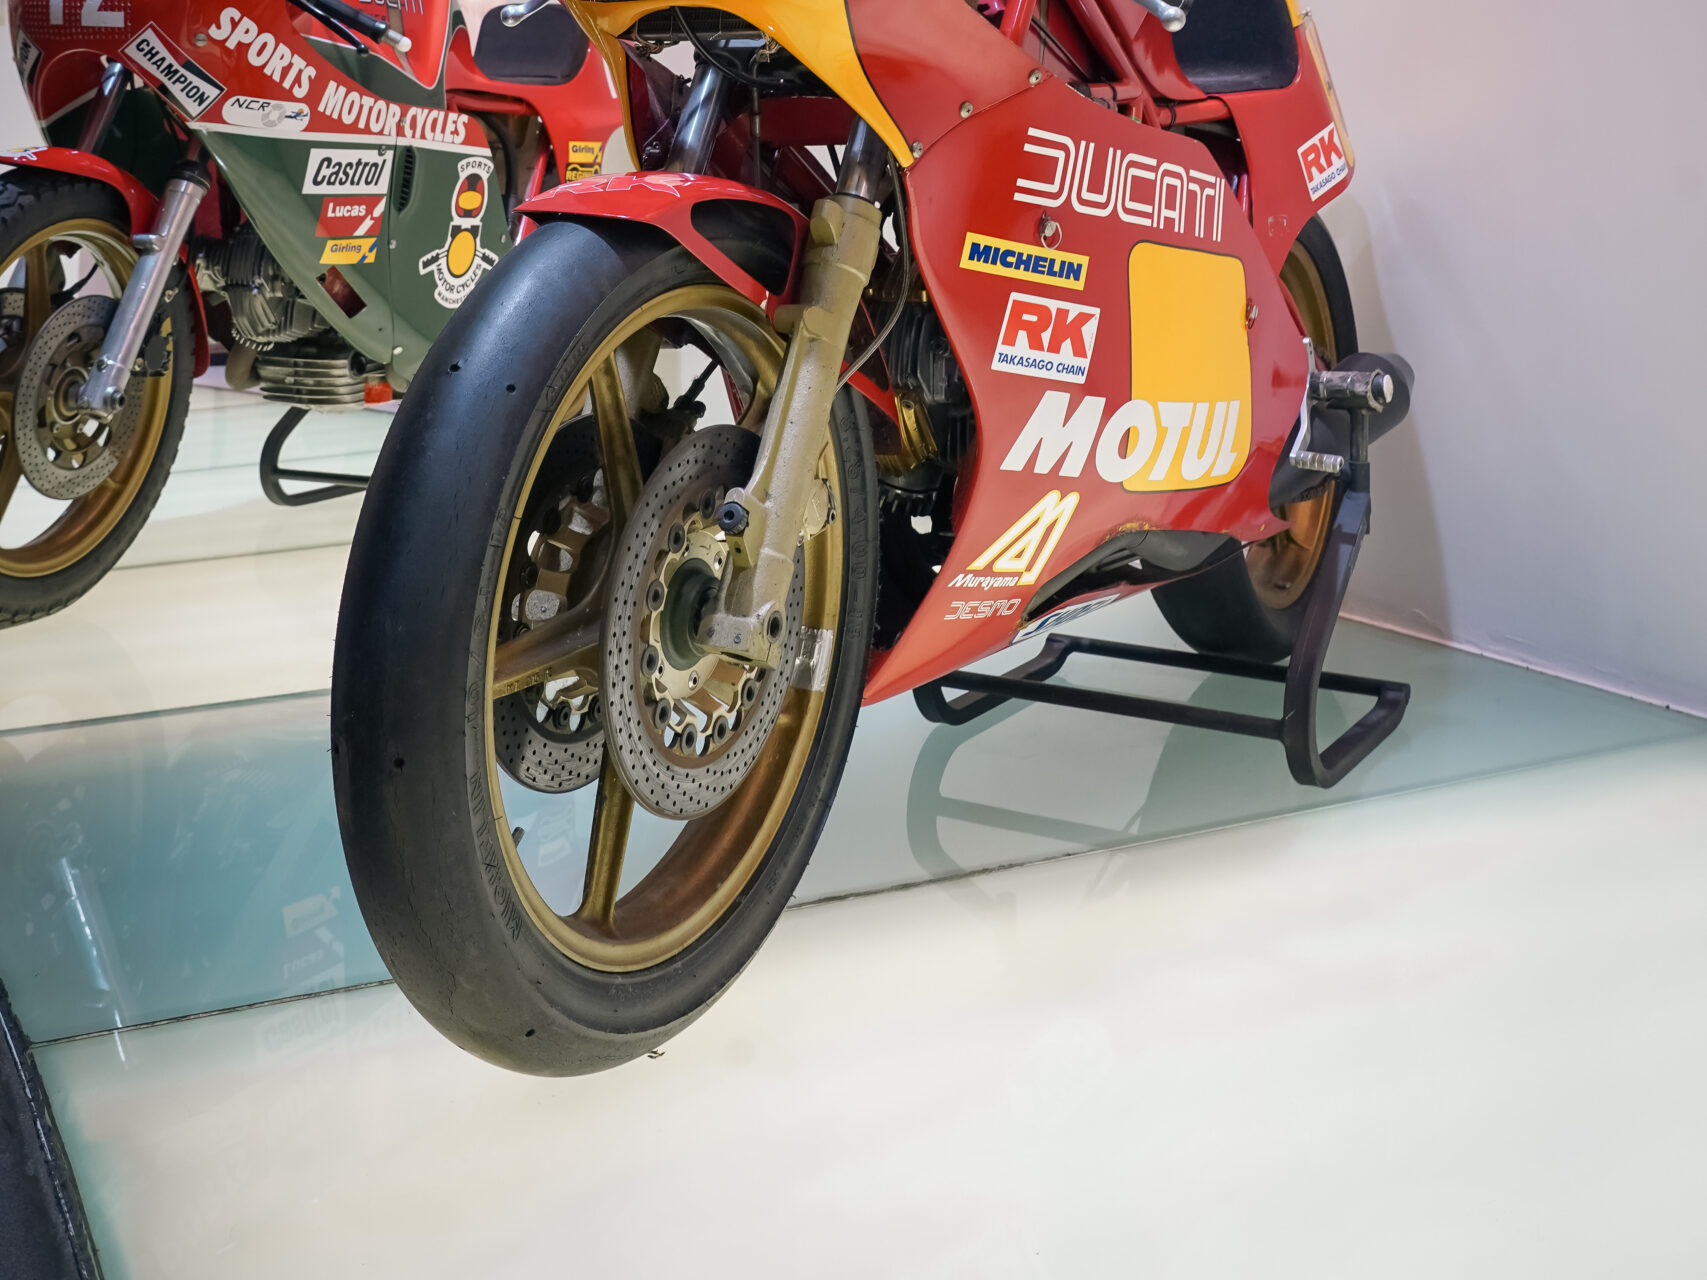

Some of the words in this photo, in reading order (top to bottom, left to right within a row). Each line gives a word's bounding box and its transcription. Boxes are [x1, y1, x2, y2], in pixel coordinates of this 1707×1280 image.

[135, 38, 209, 108] CHAMPION
[208, 7, 318, 99] SPORTS
[317, 80, 400, 136] MOTOR
[403, 106, 468, 143] CYCLES
[230, 97, 271, 113] NCR
[571, 144, 595, 155] Girling
[1300, 127, 1343, 184] RK
[312, 156, 387, 187] Castrol
[460, 160, 491, 174] SPORTS
[1013, 127, 1225, 242] DUCATI
[1310, 172, 1336, 195] TAKASAGO
[327, 202, 367, 217] Lucas
[330, 243, 362, 254] Girling
[968, 242, 1083, 282] MICHELIN
[1001, 299, 1096, 359] RK
[997, 352, 1054, 371] TAKASAGO
[1056, 363, 1086, 377] CHAIN
[1000, 390, 1240, 483] MOTUL
[947, 573, 1019, 591] Murayama
